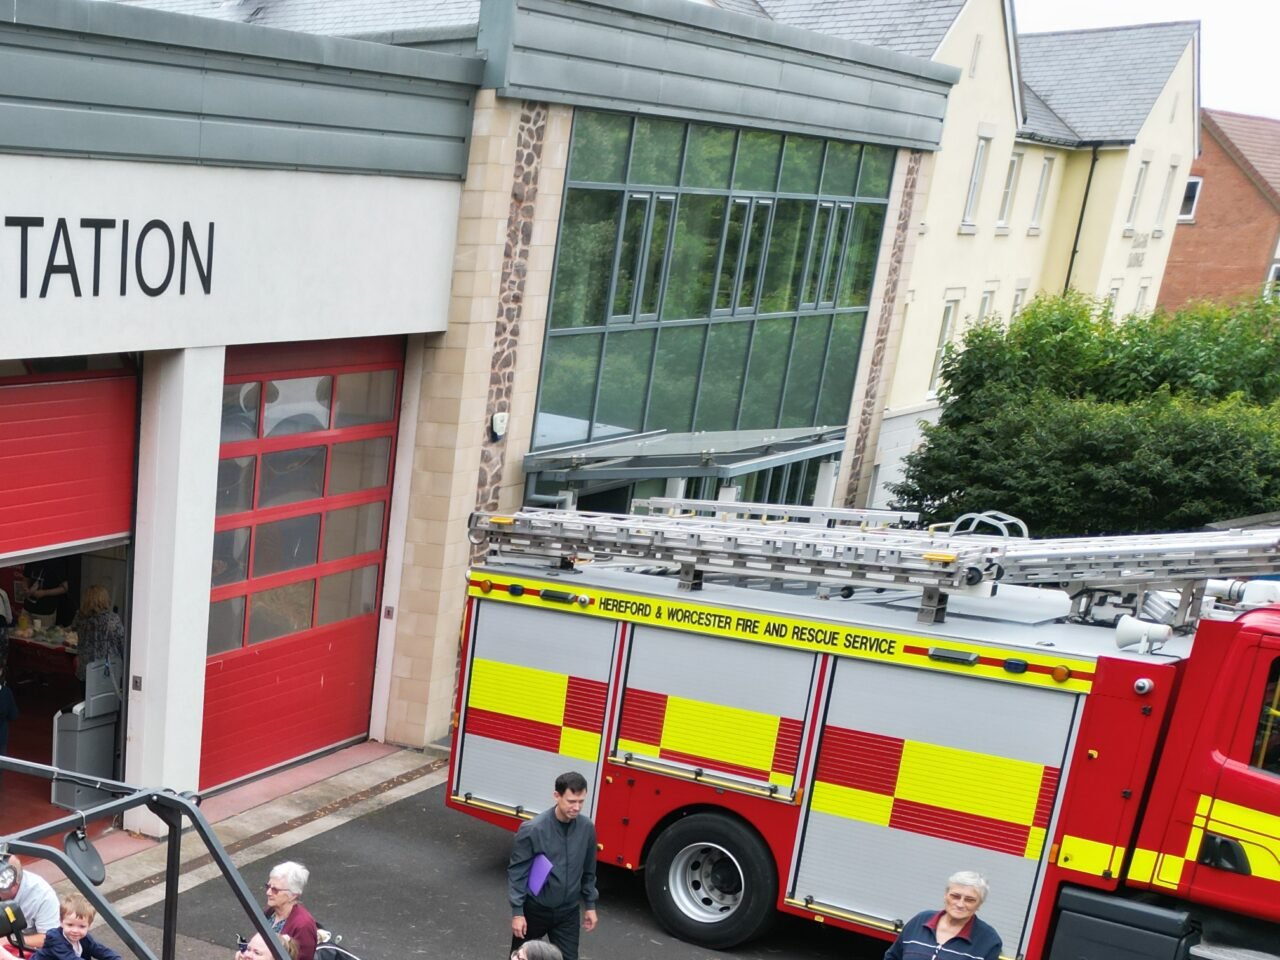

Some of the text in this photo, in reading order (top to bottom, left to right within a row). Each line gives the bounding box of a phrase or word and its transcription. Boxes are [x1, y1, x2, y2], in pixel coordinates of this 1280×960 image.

[599, 597, 897, 655] HEREFORD & WORCESTER FIRE AND RESCUE SERVICE
